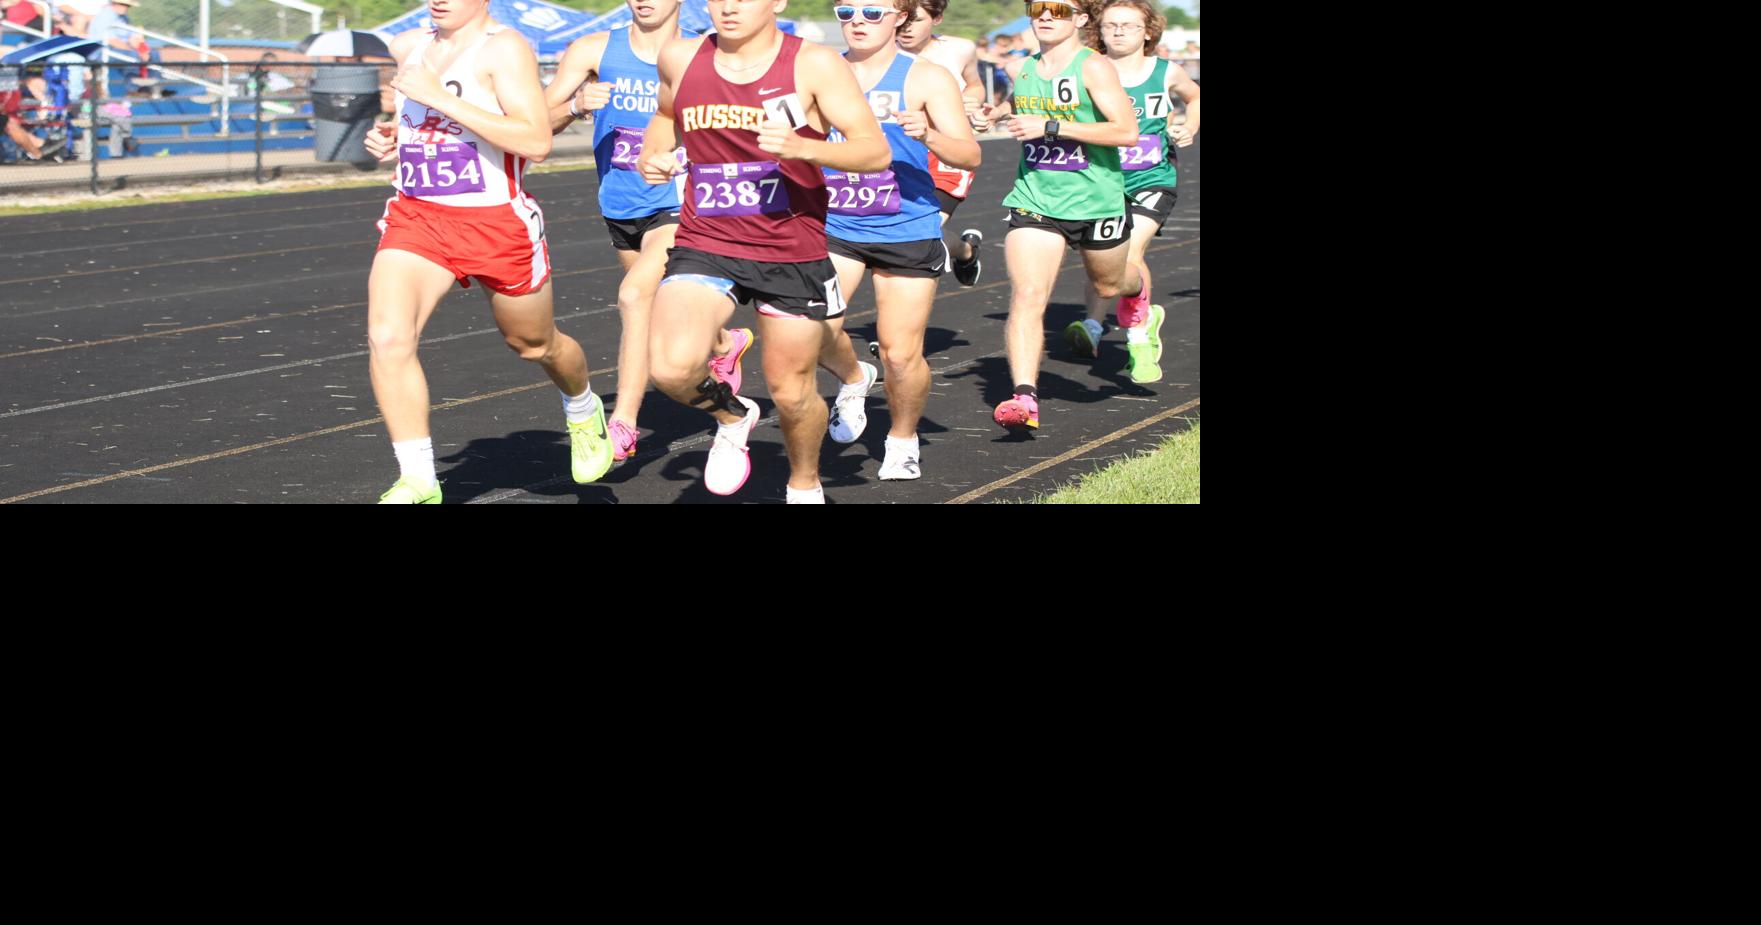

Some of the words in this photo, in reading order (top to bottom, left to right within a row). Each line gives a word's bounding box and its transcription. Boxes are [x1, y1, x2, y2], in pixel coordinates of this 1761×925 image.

[1057, 78, 1073, 104] 6
[776, 99, 798, 129] 1
[876, 93, 893, 121] 3
[1148, 95, 1163, 117] 7
[1024, 143, 1086, 165] 2224
[401, 159, 481, 188] 2154
[696, 178, 780, 209] 2387
[826, 184, 895, 209] 2297
[1100, 217, 1115, 239] 6
